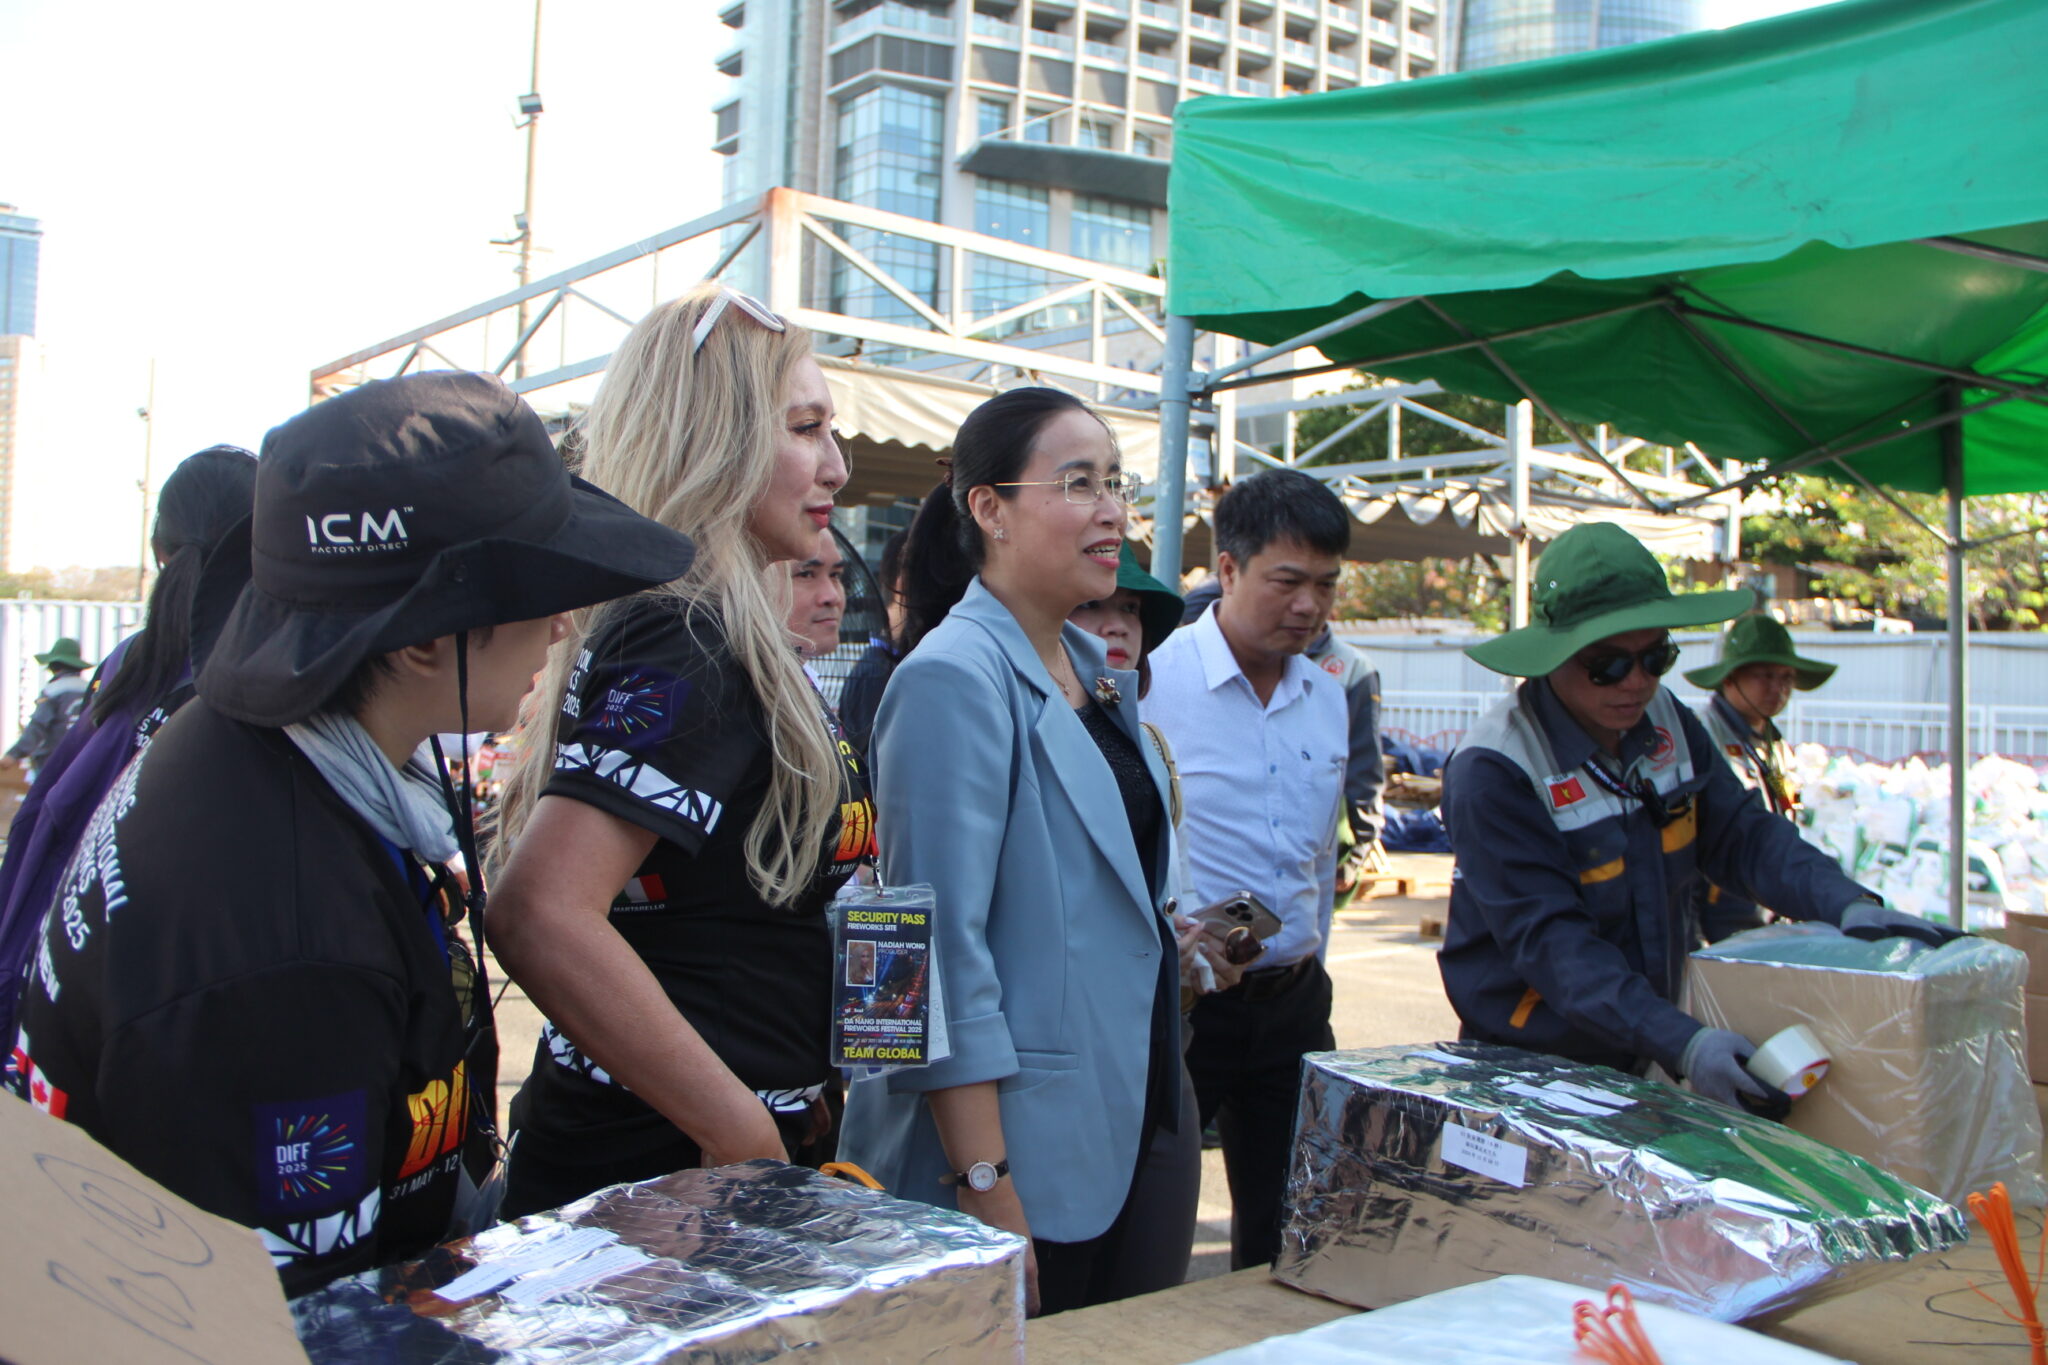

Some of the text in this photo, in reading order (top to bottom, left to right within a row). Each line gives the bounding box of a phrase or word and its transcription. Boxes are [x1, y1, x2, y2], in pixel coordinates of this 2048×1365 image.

[306, 508, 408, 544] ICM
[311, 541, 409, 553] FACTORY DIRECT
[607, 689, 634, 704] DIFF
[562, 692, 581, 718] 2025
[605, 704, 624, 713] 2025
[847, 911, 926, 925] SECURITY PASS
[847, 923, 897, 932] FIREWORKS SITE
[878, 941, 926, 950] NADIAH WONG
[876, 1018, 922, 1026] INTERNATIONAL
[880, 1025, 906, 1033] FESTIVAL
[843, 1047, 922, 1059] TEAM GLOBAL
[275, 1142, 312, 1164] DIFF
[277, 1162, 308, 1175] 2025
[388, 1182, 408, 1200] 31
[444, 1154, 459, 1173] 12
